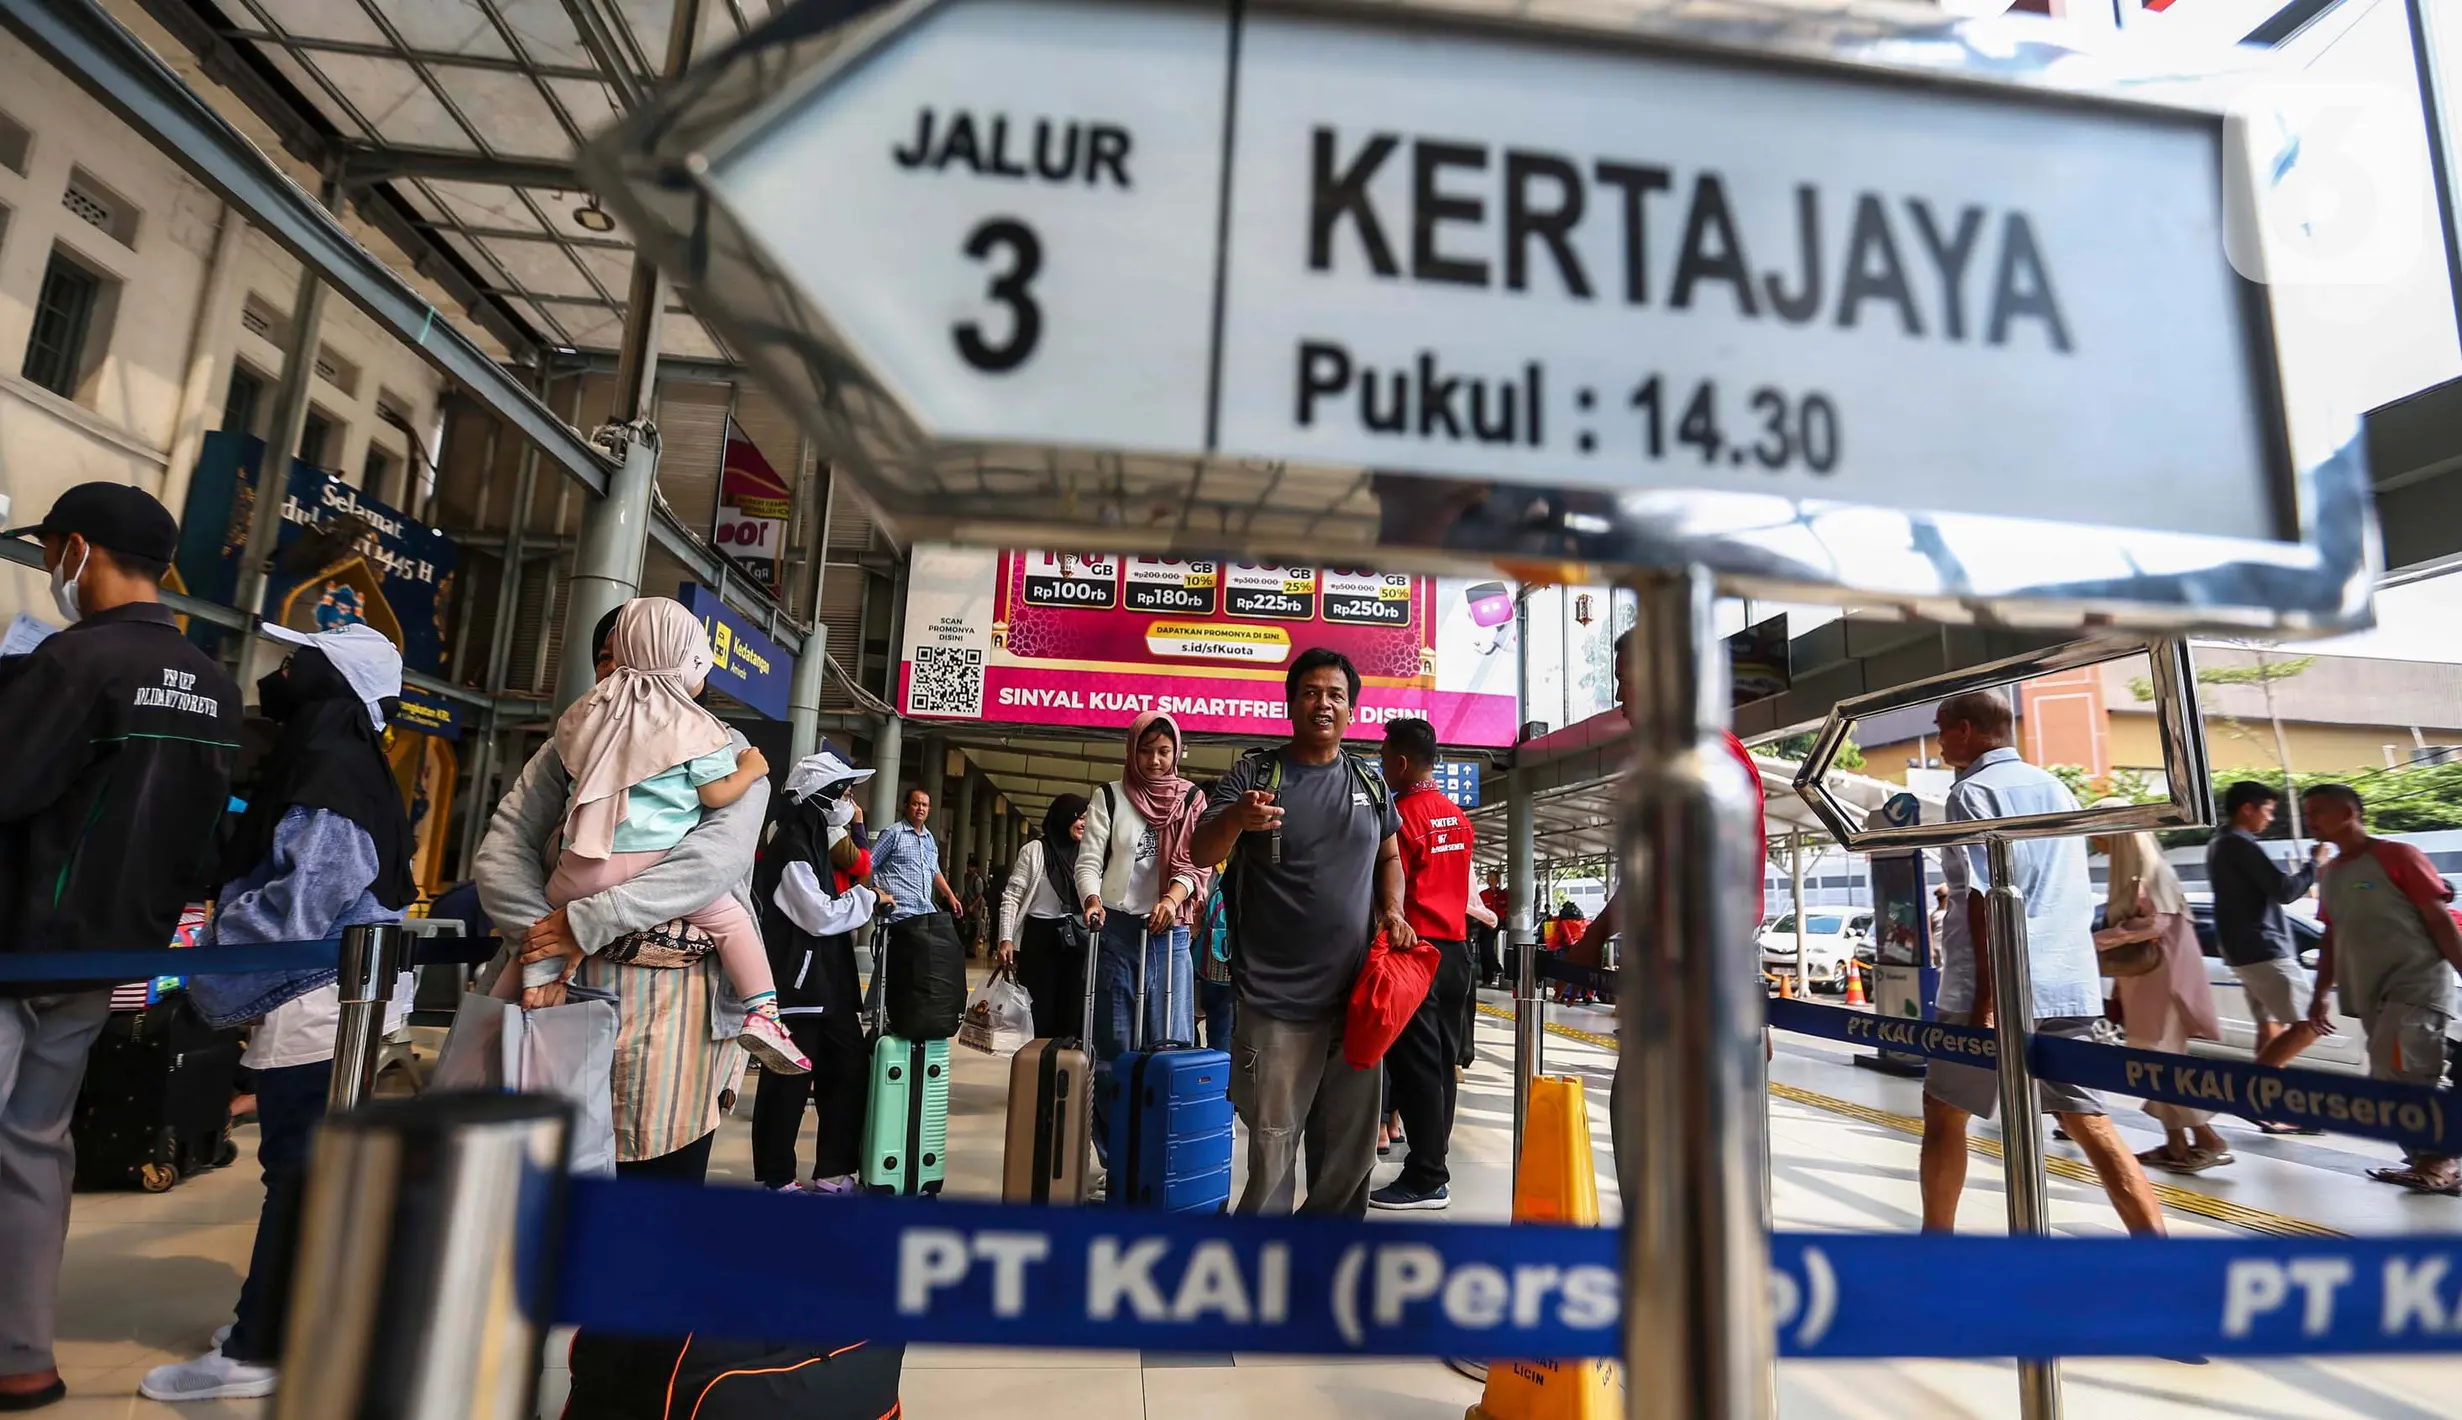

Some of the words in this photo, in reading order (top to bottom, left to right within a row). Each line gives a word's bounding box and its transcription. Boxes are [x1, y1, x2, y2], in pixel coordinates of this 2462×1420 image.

[892, 107, 1134, 190] JALUR
[1306, 125, 2075, 355] KERTAJAYA
[951, 214, 1044, 376] 3
[1293, 339, 1543, 448] Pukul
[1630, 372, 1840, 476] 14.30
[281, 494, 319, 526] dul
[320, 483, 404, 539] Selamat
[417, 558, 435, 584] H
[1091, 564, 1113, 576] GB
[1191, 562, 1213, 574] GB
[1289, 568, 1311, 579] GB
[1186, 576, 1213, 586] 10%
[1285, 582, 1312, 592] 25%
[1385, 575, 1406, 586] GB
[1033, 582, 1107, 601] Rp100rb
[1137, 589, 1203, 607] Rp180rb
[1381, 588, 1409, 598] 50%
[1237, 594, 1302, 612] Rp225rb
[1333, 600, 1399, 619] Rp250rb
[928, 625, 975, 634] PROMONYA
[940, 617, 963, 625] SCAN
[938, 634, 963, 642] DISINI
[1156, 626, 1203, 635] DAPATKAN
[1204, 630, 1251, 639] PROMONYA
[733, 636, 770, 675] Kedatangan
[1181, 643, 1253, 655] s.id/sfKuota
[998, 687, 1084, 709] SINYAL
[1089, 692, 1153, 712] KUAT
[1157, 697, 1288, 719] SMARTFRE
[1848, 1016, 1874, 1037] PT
[1878, 1022, 1916, 1045] KAI
[1921, 1026, 1996, 1057] (Perse
[2125, 1060, 2163, 1092] PT
[2174, 1066, 2235, 1102] KAI
[2246, 1075, 2444, 1142] (Persero)
[899, 1227, 1049, 1319] PT
[1086, 1234, 1292, 1323] KAI
[2222, 1257, 2353, 1339] PT
[1513, 1362, 1544, 1386] LICIN
